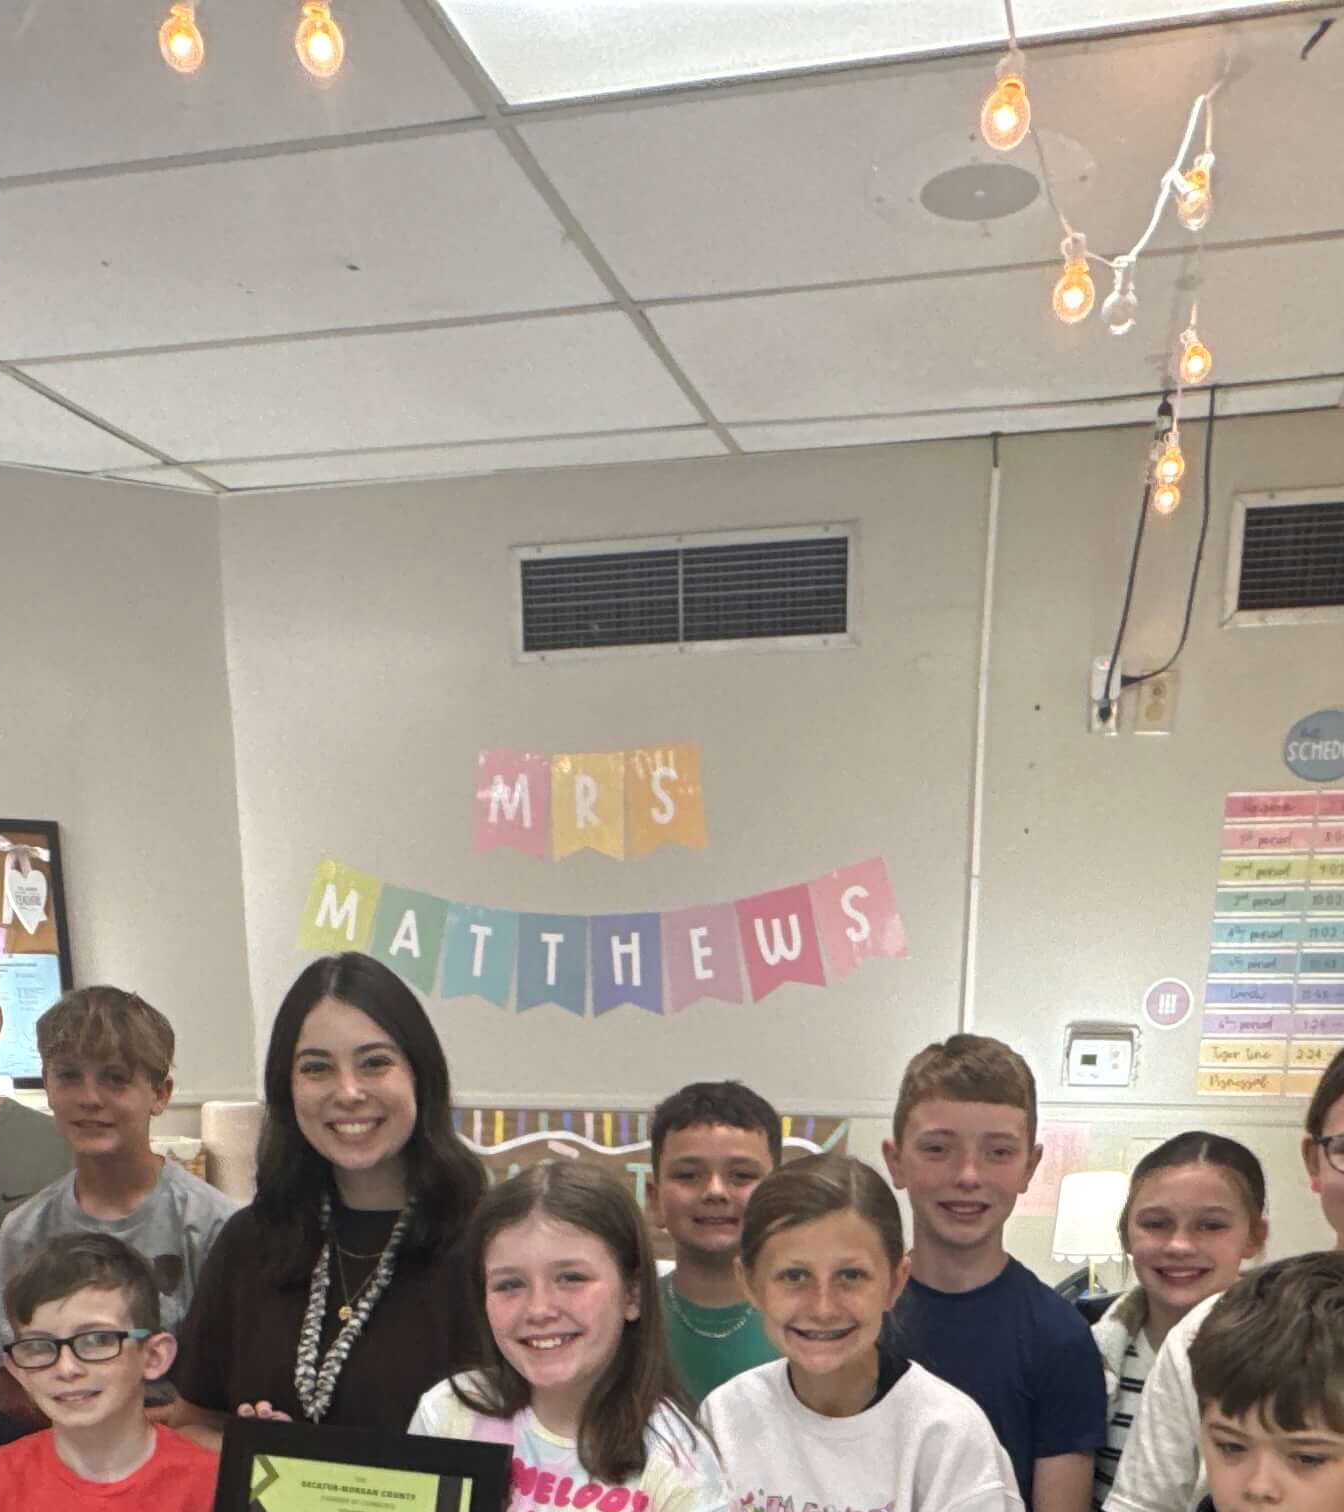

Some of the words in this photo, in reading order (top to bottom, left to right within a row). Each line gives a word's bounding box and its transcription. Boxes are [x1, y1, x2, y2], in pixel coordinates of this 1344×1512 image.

[488, 766, 680, 830] MRS
[314, 883, 871, 987] MATTHEWS
[1211, 1046, 1240, 1062] Tiger
